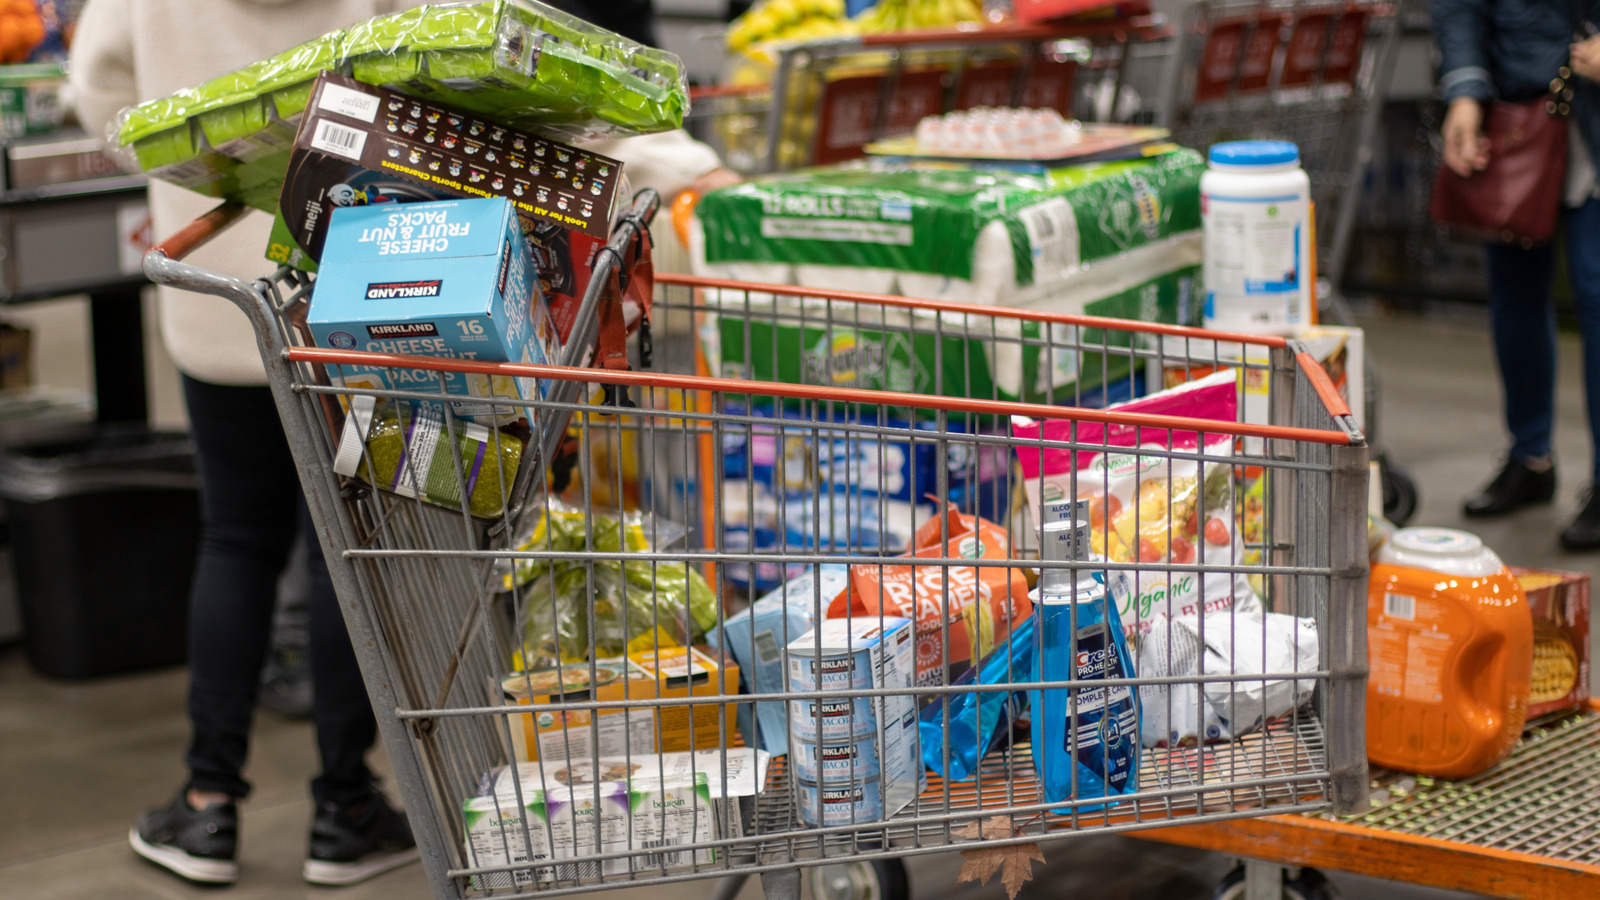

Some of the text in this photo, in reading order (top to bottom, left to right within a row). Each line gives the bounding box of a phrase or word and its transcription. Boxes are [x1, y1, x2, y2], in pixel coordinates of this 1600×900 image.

[380, 160, 430, 181] Characters
[431, 175, 462, 193] Sports
[463, 185, 492, 199] Panda
[517, 200, 534, 213] the
[532, 203, 549, 217] All
[784, 195, 845, 217] ROLLS
[304, 200, 323, 231] meiji
[388, 211, 447, 227] PACKS
[549, 208, 564, 221] for
[564, 215, 588, 229] Look
[358, 222, 470, 242] FRUIT & NUT
[269, 243, 290, 262] 32
[376, 237, 449, 255] CHEESE,
[498, 241, 510, 291] KIRKLAND
[367, 285, 438, 299] KIRKLAND
[370, 323, 434, 334] KIRKLAND
[456, 319, 484, 335] 16
[366, 338, 454, 354] CHEESE,
[1052, 502, 1084, 512] ALCOOL
[1059, 531, 1084, 541] ALCOL
[1067, 539, 1081, 548] FE
[883, 566, 978, 604] RICE
[900, 583, 993, 622] RAMEN
[914, 613, 957, 633] OODLS
[812, 659, 855, 669] KRKLAND
[809, 671, 858, 682] ABACOE
[917, 666, 944, 682] OTUS
[1069, 688, 1111, 706] OMPLEE
[811, 702, 853, 713] KRKLAN
[809, 715, 858, 726] ABACOE
[815, 746, 857, 756] RKLAND
[813, 760, 859, 769] ABACOE
[823, 788, 862, 799] KIRKLAD
[823, 801, 865, 812] LBACORE
[514, 854, 546, 862] BOUSIN
